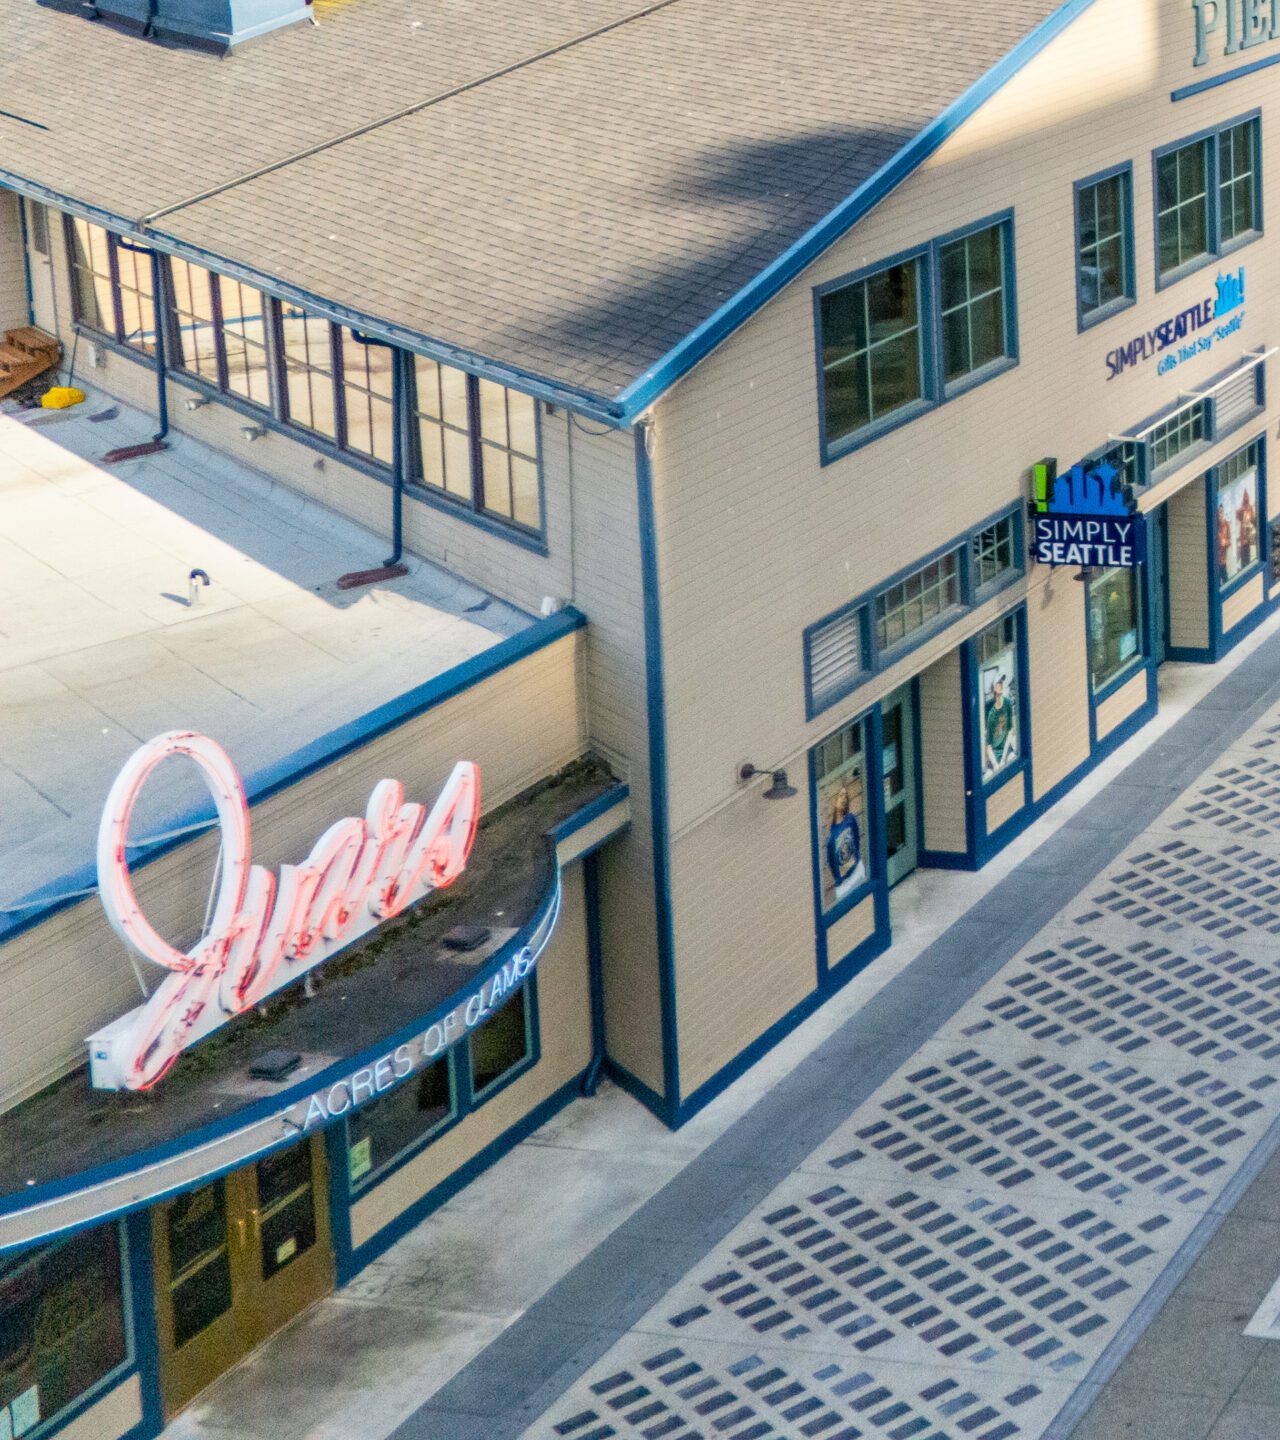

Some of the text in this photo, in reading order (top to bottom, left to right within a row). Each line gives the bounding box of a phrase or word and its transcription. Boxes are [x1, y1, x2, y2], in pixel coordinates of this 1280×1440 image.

[1178, 341, 1197, 363] That
[1198, 336, 1212, 351] Say
[1038, 519, 1131, 543] SIMPLY
[1038, 542, 1133, 566] SEATTLE
[304, 946, 532, 1131] ACRES OF CLAMS
